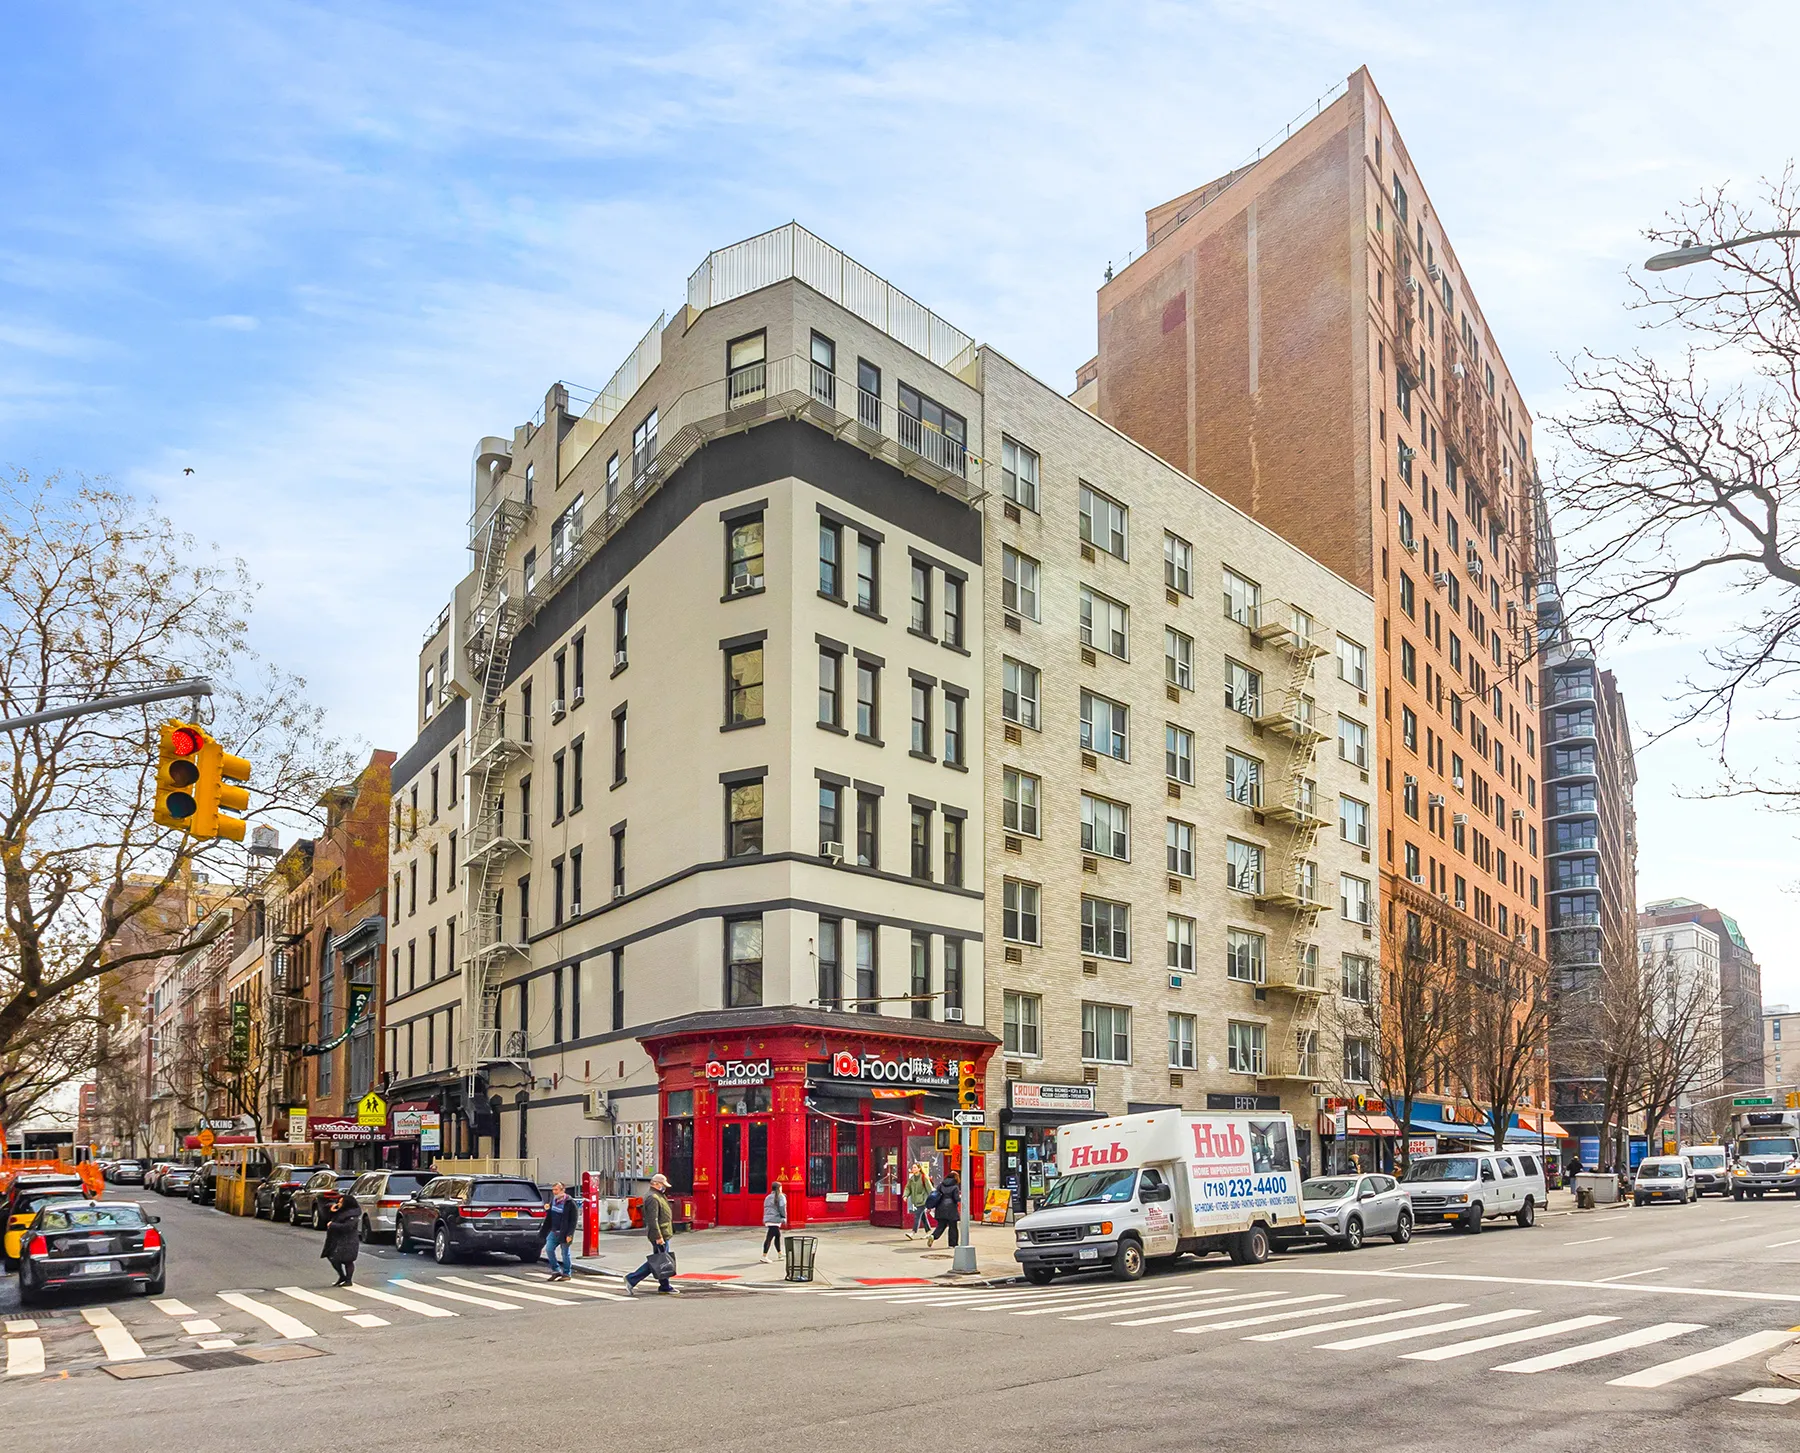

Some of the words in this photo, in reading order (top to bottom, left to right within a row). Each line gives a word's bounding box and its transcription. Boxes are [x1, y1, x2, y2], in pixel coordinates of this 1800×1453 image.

[726, 1058, 770, 1078] Food
[1013, 1085, 1040, 1097] CROWN
[1014, 1097, 1040, 1106] SERVICES
[1234, 1096, 1259, 1110] EFFY
[958, 1114, 968, 1122] ONE
[292, 1125, 303, 1133] 15
[1191, 1123, 1245, 1158] Hub
[1069, 1142, 1129, 1168] Hub
[1193, 1166, 1210, 1176] HOME
[1210, 1165, 1249, 1176] IMPROVEMENTS
[1203, 1181, 1228, 1199] (718)
[1228, 1176, 1287, 1198] 232-4400
